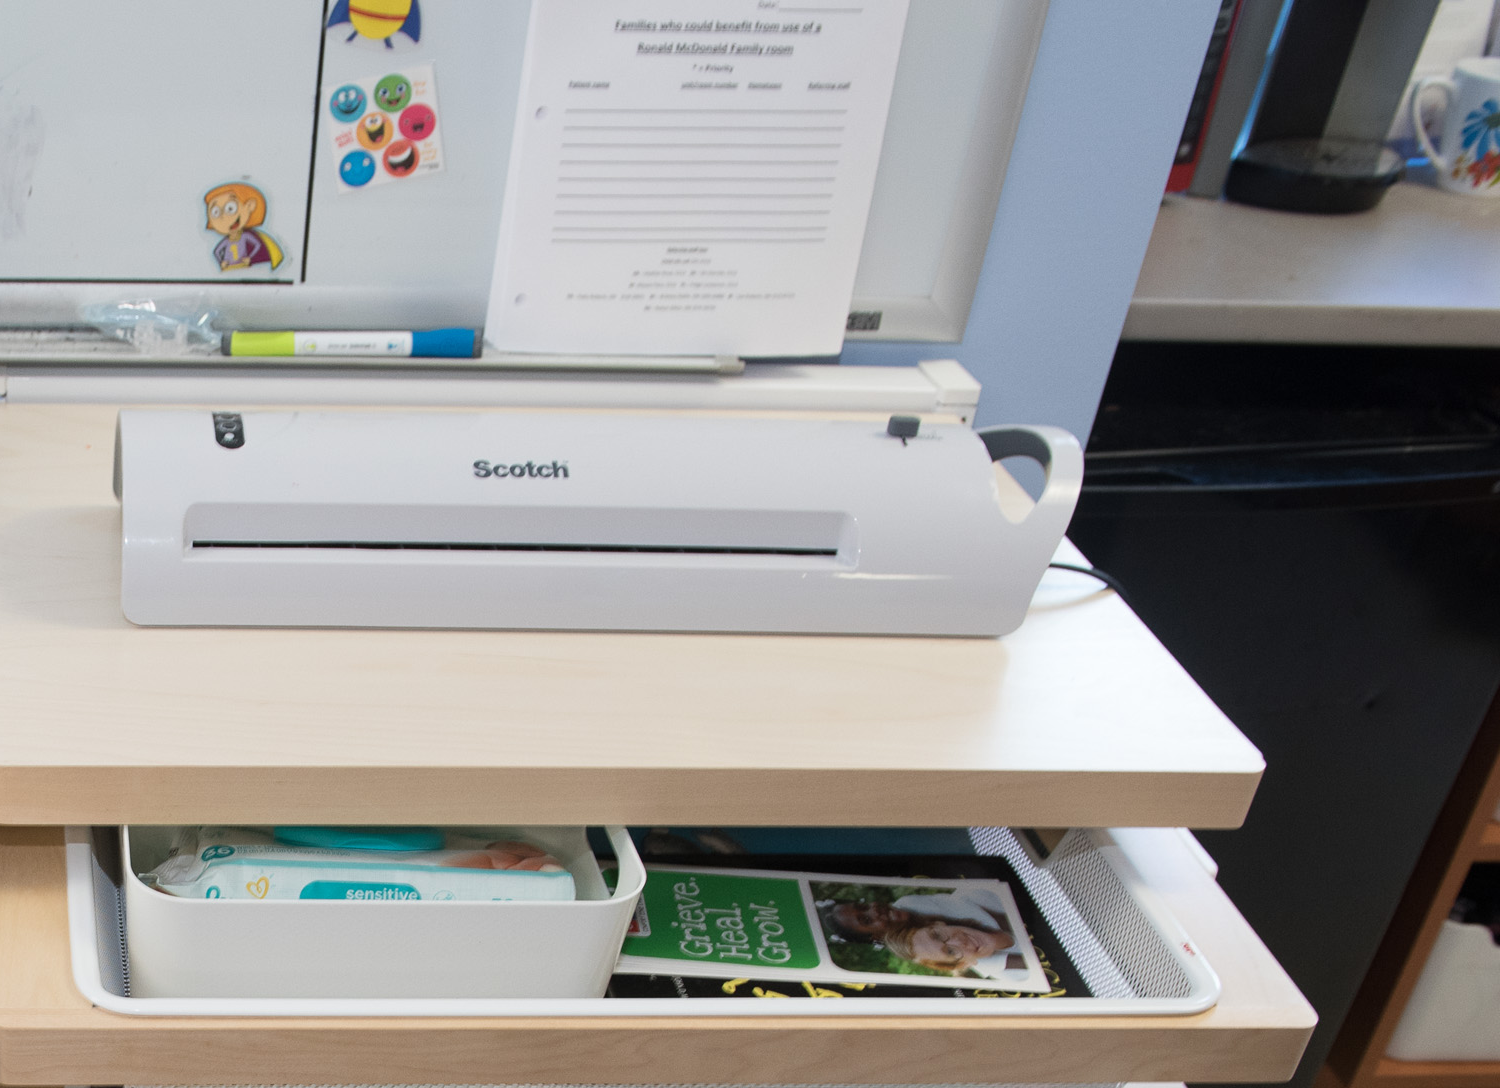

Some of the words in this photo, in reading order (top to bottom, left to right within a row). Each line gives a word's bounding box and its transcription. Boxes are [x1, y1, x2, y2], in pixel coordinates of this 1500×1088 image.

[614, 20, 657, 32] Families
[660, 20, 681, 32] who
[685, 20, 713, 32] could
[716, 20, 752, 32] benefit
[755, 20, 780, 32] from
[782, 20, 799, 32] use
[802, 20, 814, 32] of
[637, 42, 673, 55] Ronald
[675, 42, 728, 55] McDonald
[730, 42, 763, 55] Family
[766, 42, 794, 55] room
[473, 459, 570, 478] Scotch
[345, 887, 418, 900] sensitive
[671, 876, 714, 958] Grieve.
[704, 902, 752, 961] Heal.
[749, 900, 792, 963] Grow.
